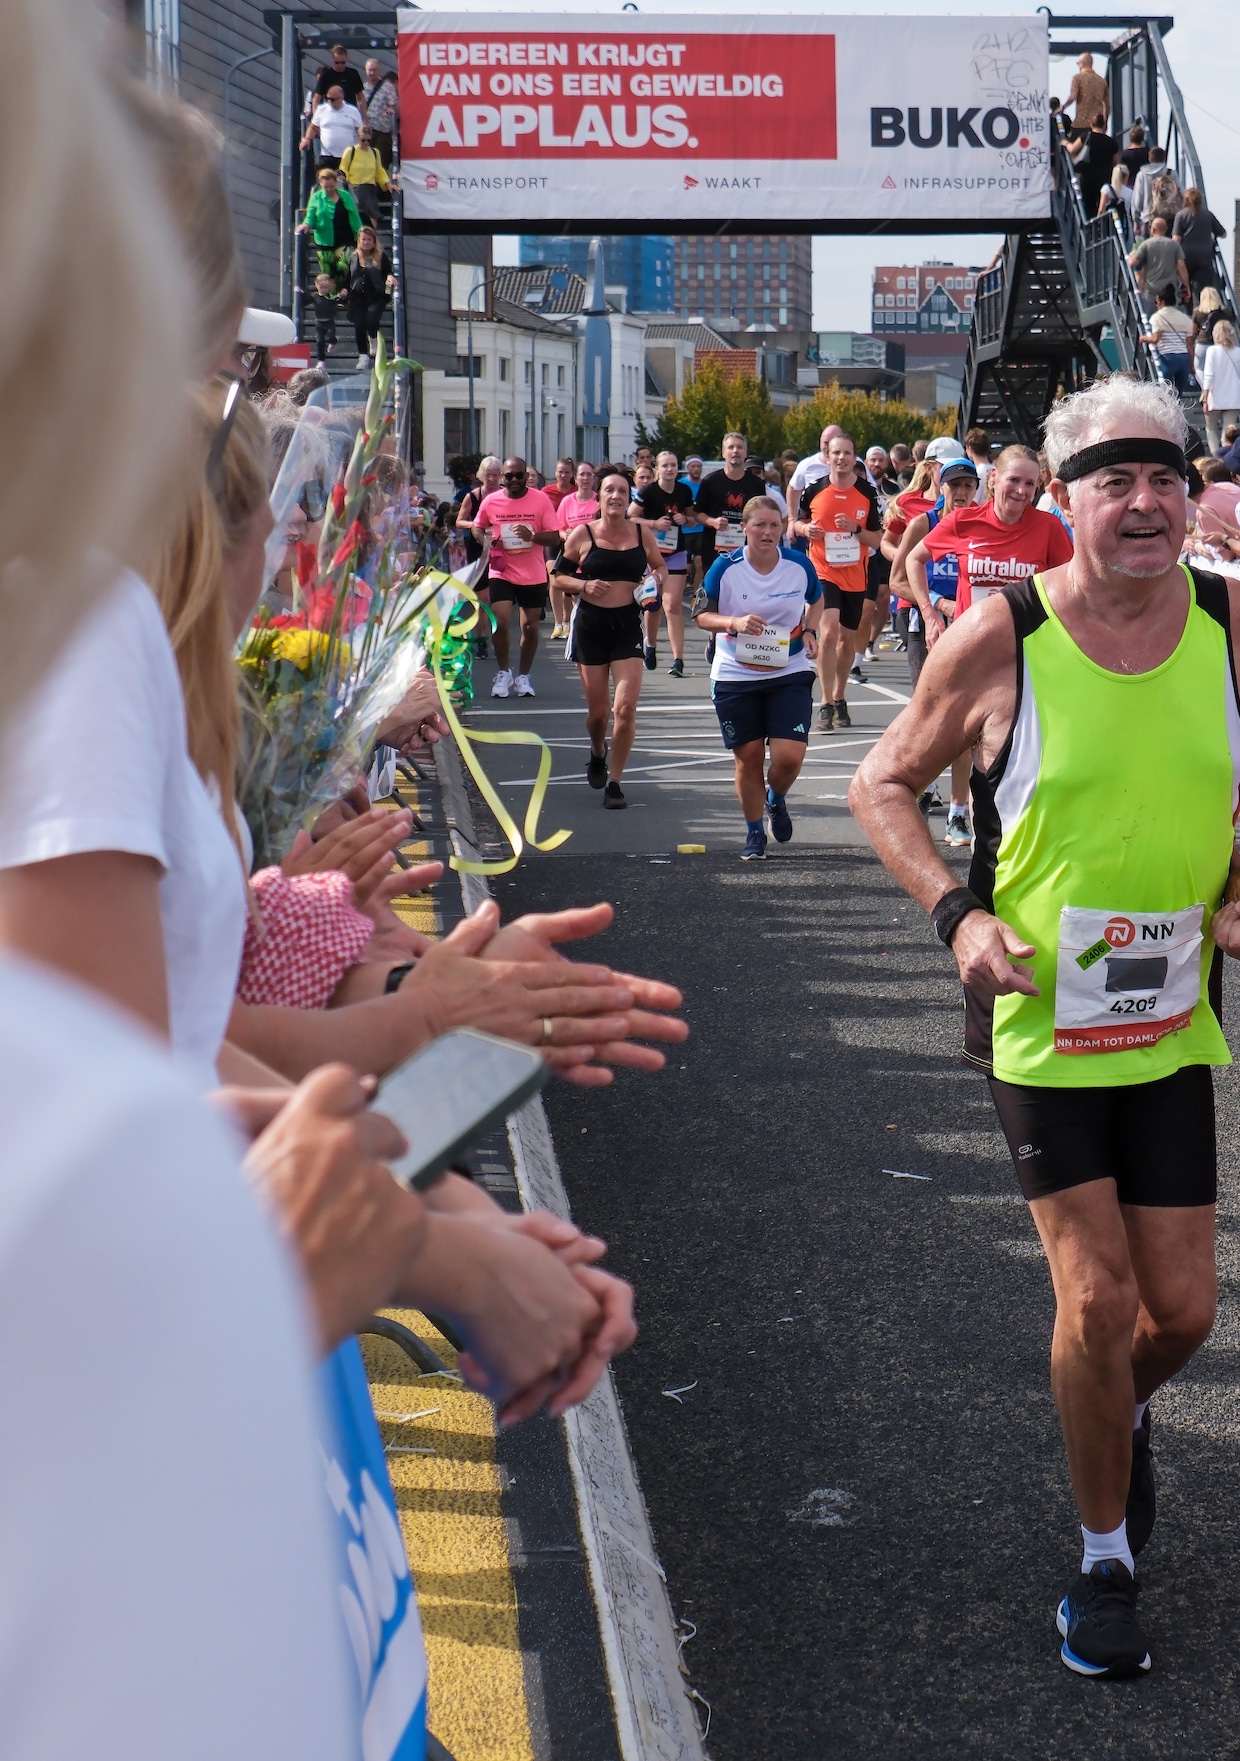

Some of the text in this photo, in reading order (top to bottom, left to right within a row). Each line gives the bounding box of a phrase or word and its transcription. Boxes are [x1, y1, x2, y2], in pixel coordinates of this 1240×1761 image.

[419, 43, 686, 67] IEDEREEN KRIJGT
[419, 73, 784, 98] VAN ONS EEN GEWELDIG
[421, 104, 699, 149] APPLAUS.
[448, 177, 548, 189] TRANSPORT
[705, 177, 763, 189] WAAKT
[904, 177, 1031, 190] INFRASUPPORT
[967, 553, 1035, 578] intralox
[759, 645, 780, 653] NZKG
[752, 654, 770, 662] 9630
[1142, 922, 1175, 941] NN
[1083, 946, 1105, 964] 2406
[1110, 997, 1157, 1014] 4209
[1057, 1039, 1073, 1048] NN
[1075, 1039, 1101, 1048] DAM
[1103, 1038, 1124, 1047] TOT
